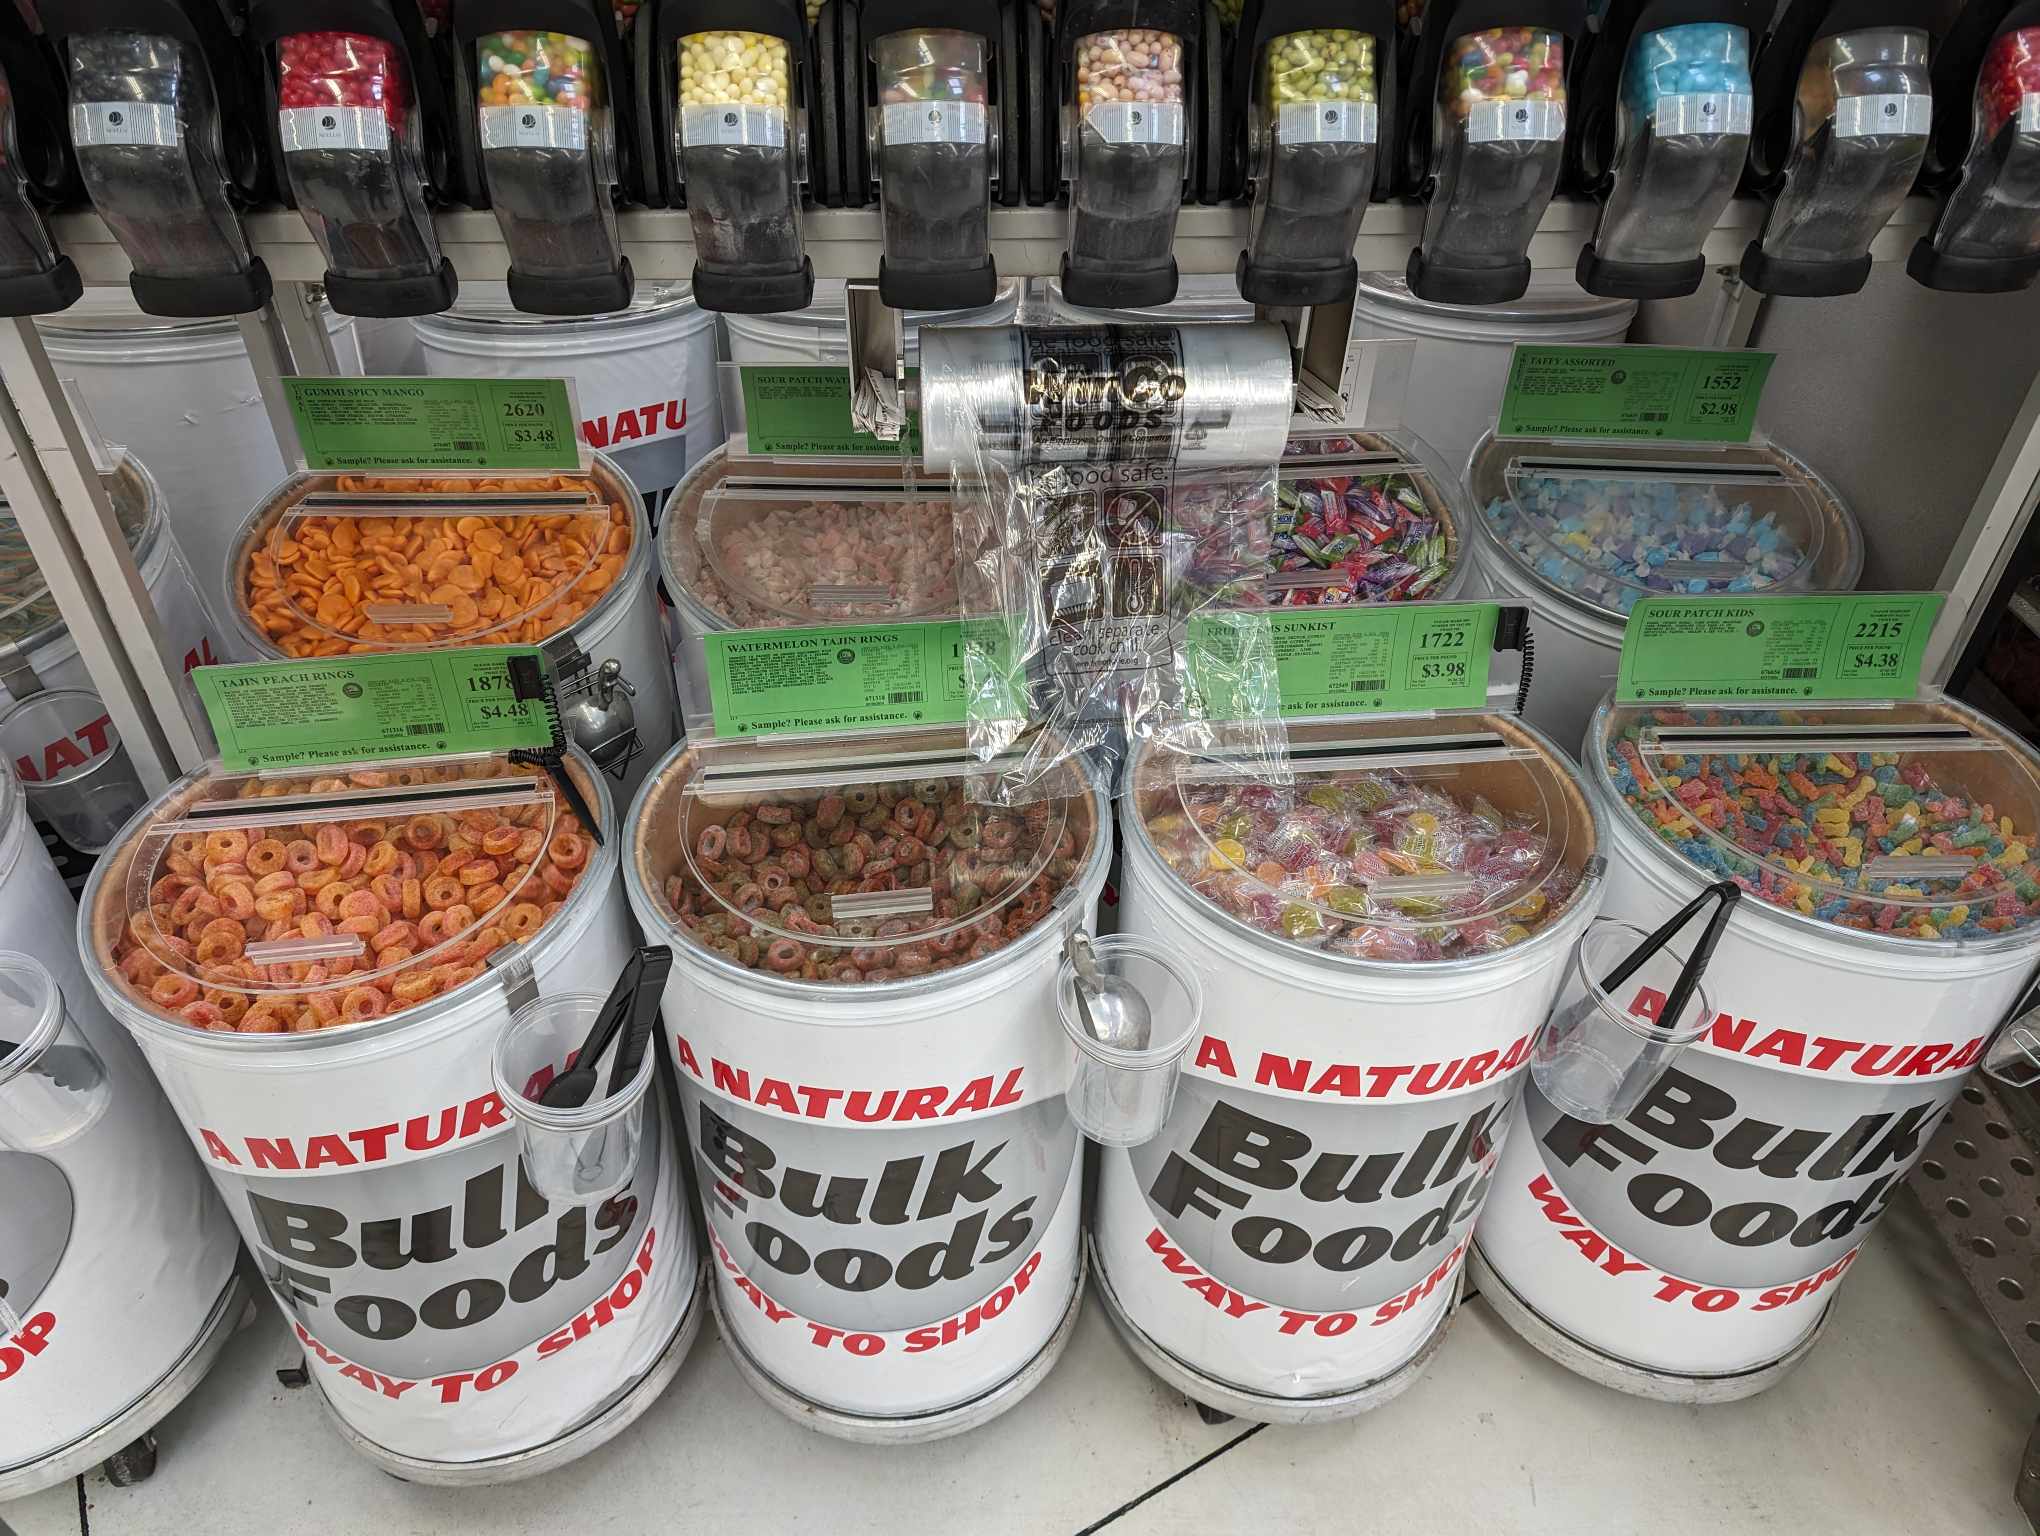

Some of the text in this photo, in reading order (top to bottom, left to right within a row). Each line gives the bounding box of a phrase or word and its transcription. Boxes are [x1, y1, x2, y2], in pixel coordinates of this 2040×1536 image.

[757, 376, 787, 384] SOUR
[789, 376, 821, 384] PATCH
[1703, 375, 1741, 390] 1552
[303, 388, 424, 397] GUMMI SPICY MANGO
[503, 403, 545, 417] 2620
[1700, 402, 1738, 416] $2.98
[514, 429, 554, 442] $3.48
[776, 442, 809, 452] Sample?
[812, 442, 834, 451] Please
[835, 443, 848, 451] ask
[851, 443, 863, 451] for
[336, 456, 473, 465] Sample? Please ask for assistance.
[1120, 463, 1168, 482] safe.
[1648, 608, 1755, 618] SOUR PATCH KIDS
[1283, 621, 1337, 633] SUNKIST
[1855, 622, 1904, 638] 2215
[727, 634, 899, 653] WATERMELON TAJIN RINGS
[1420, 631, 1465, 649] 1722
[1422, 661, 1465, 679] $3.98
[1854, 653, 1899, 668] $4.38
[220, 669, 355, 688] TAJIN PEACH RINGS
[1648, 686, 1799, 697] Sample? Please ask for assistance.
[480, 702, 529, 719] $4.48
[1287, 699, 1367, 711] ask for assistance.
[751, 710, 908, 731] Sample? Please ask for assistance.
[262, 742, 430, 762] Sample? Please ask for assistance.
[1626, 985, 1667, 1025] A
[1194, 1024, 1542, 1098] A NATURAL
[677, 1033, 1025, 1123] A NATURAL
[1626, 1066, 1949, 1181] Bulk
[200, 1127, 241, 1168] A
[1189, 1097, 1513, 1204] Bulk
[700, 1110, 1010, 1226] Bulk
[697, 1145, 1038, 1292] Foods
[1148, 1149, 1488, 1273] Foods
[1527, 1173, 1652, 1278] WAY
[1654, 1274, 1741, 1313] TO
[256, 1185, 638, 1341] Foods
[707, 1221, 1042, 1358] WAY TO SHOP
[1144, 1227, 1272, 1320] WAY
[1276, 1309, 1359, 1338] TO
[294, 1226, 657, 1403] WAY TO SHOP
